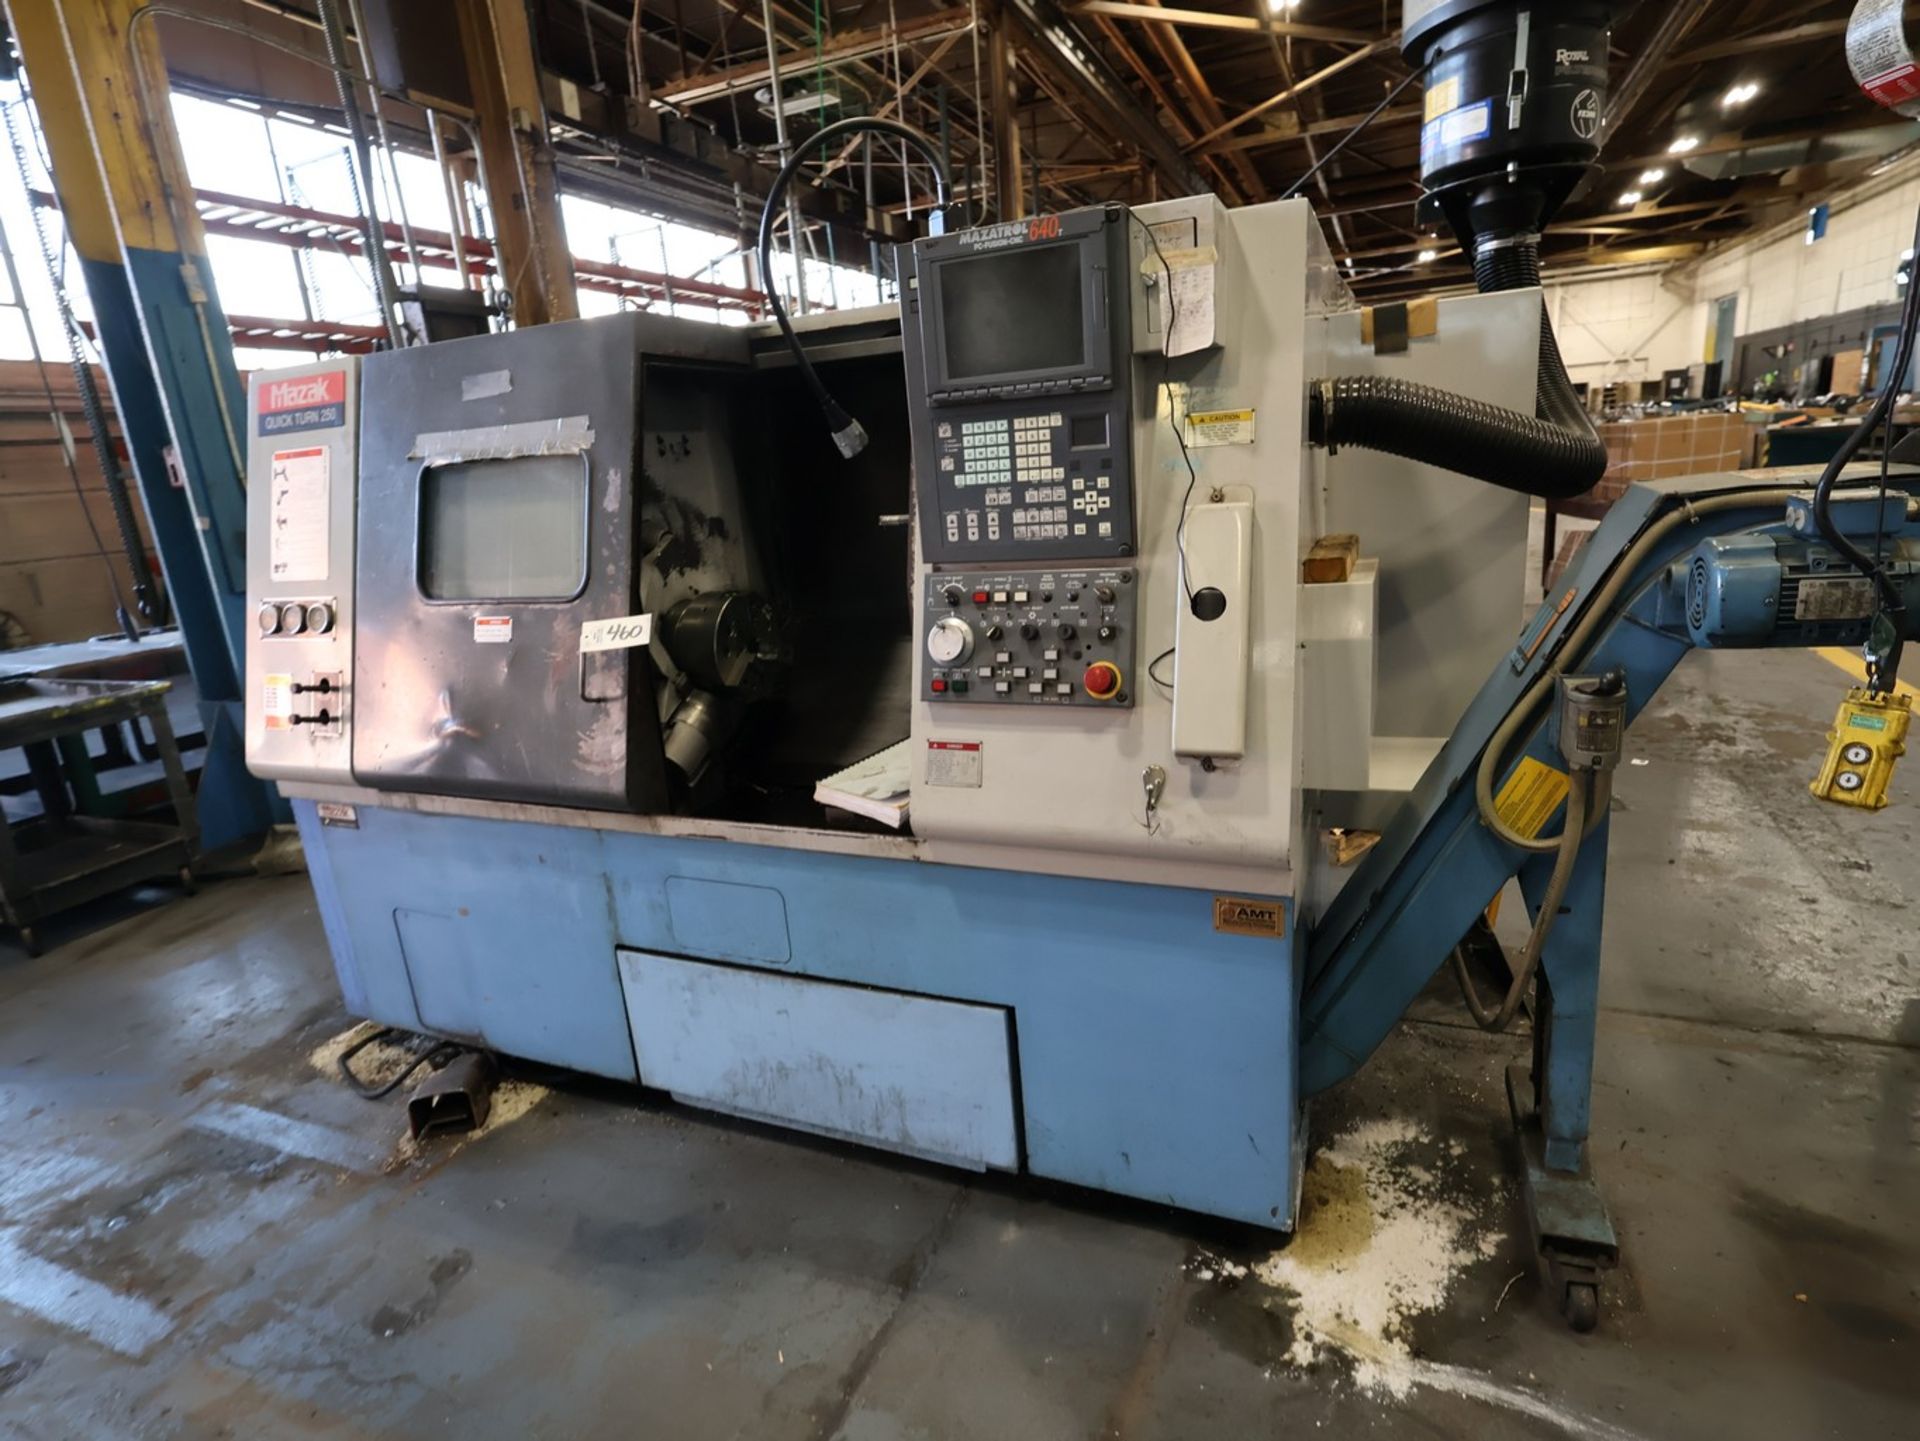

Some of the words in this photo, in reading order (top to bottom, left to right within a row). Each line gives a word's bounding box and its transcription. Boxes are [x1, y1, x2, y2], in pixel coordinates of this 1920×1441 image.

[959, 222, 1028, 245] MAZATROL
[270, 376, 329, 409] Mazak
[265, 412, 294, 429] QUICK
[295, 410, 319, 427] TURN
[320, 407, 337, 423] 250
[1209, 413, 1241, 422] CAUTION
[606, 623, 643, 641] 460
[1236, 907, 1276, 919] AMT
